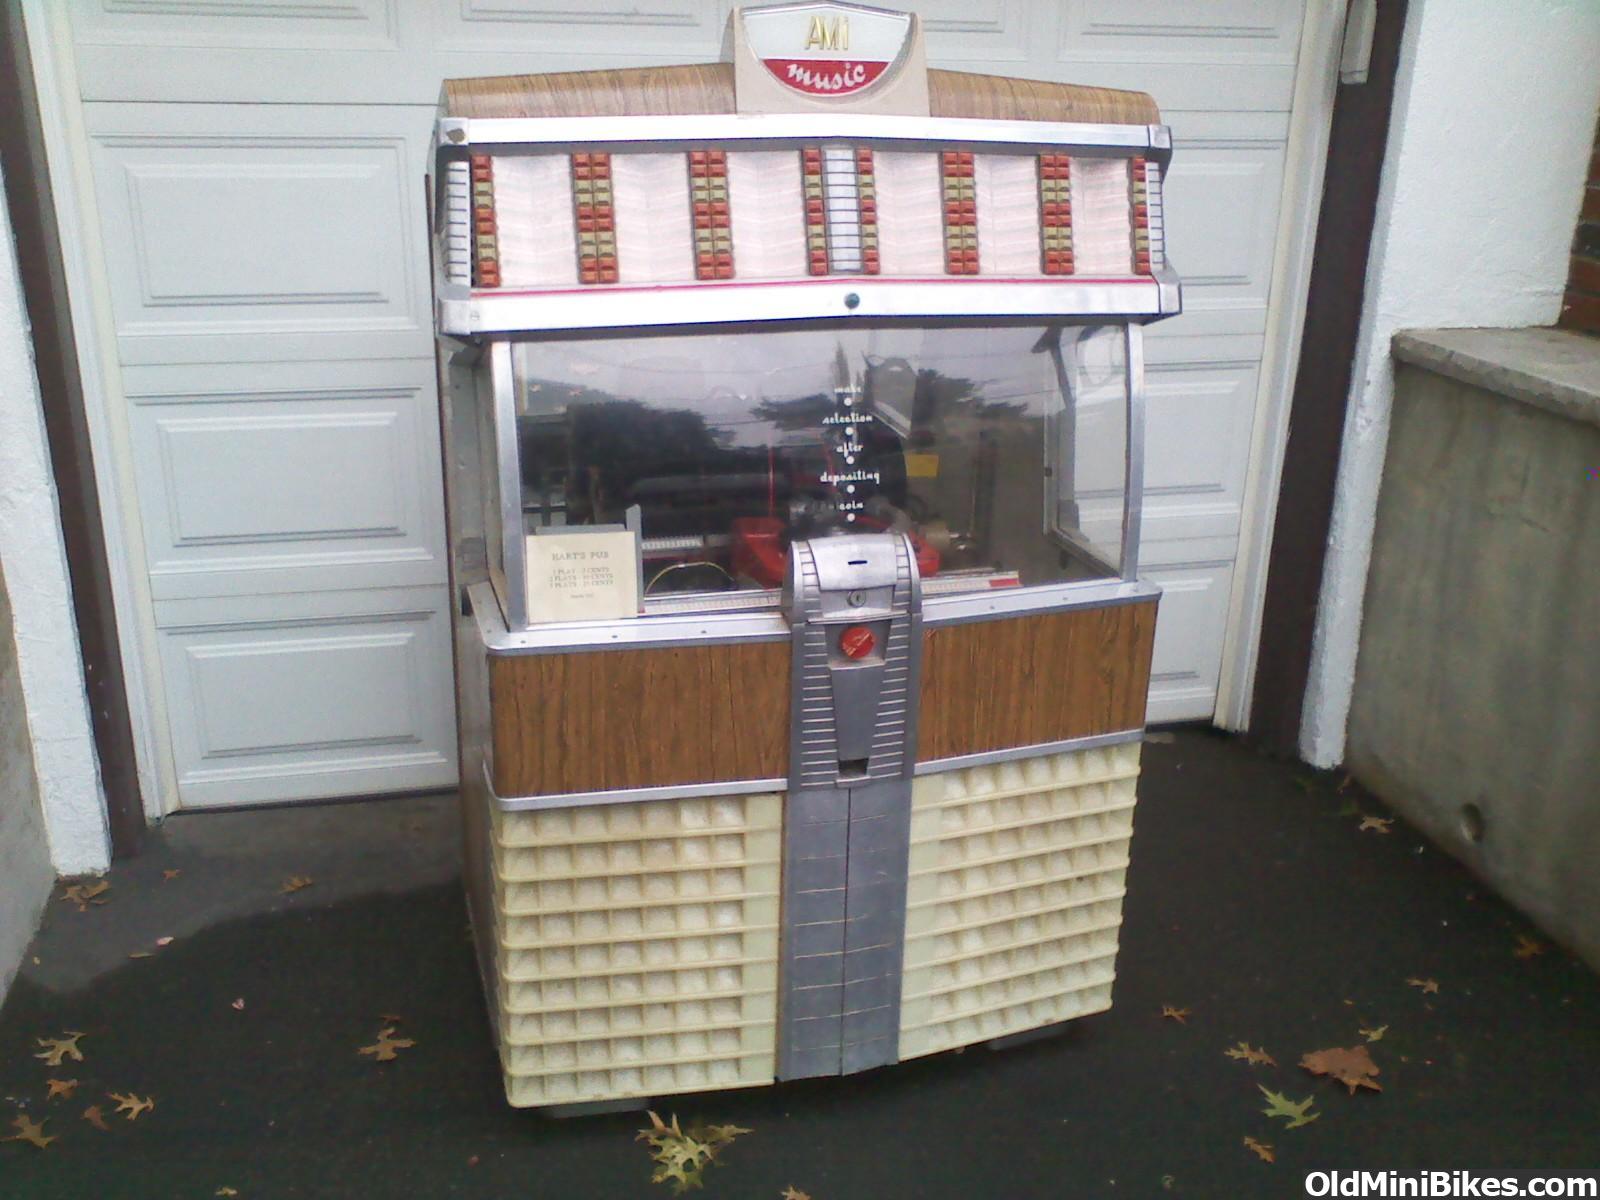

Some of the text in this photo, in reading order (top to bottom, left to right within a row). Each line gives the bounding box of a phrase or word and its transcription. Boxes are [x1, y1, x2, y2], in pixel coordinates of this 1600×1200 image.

[786, 62, 866, 90] music
[834, 383, 862, 394] make
[822, 411, 873, 425] selection
[836, 442, 864, 458] after
[820, 470, 880, 487] depositing
[839, 500, 864, 511] coin
[552, 551, 609, 561] HART'S PUB
